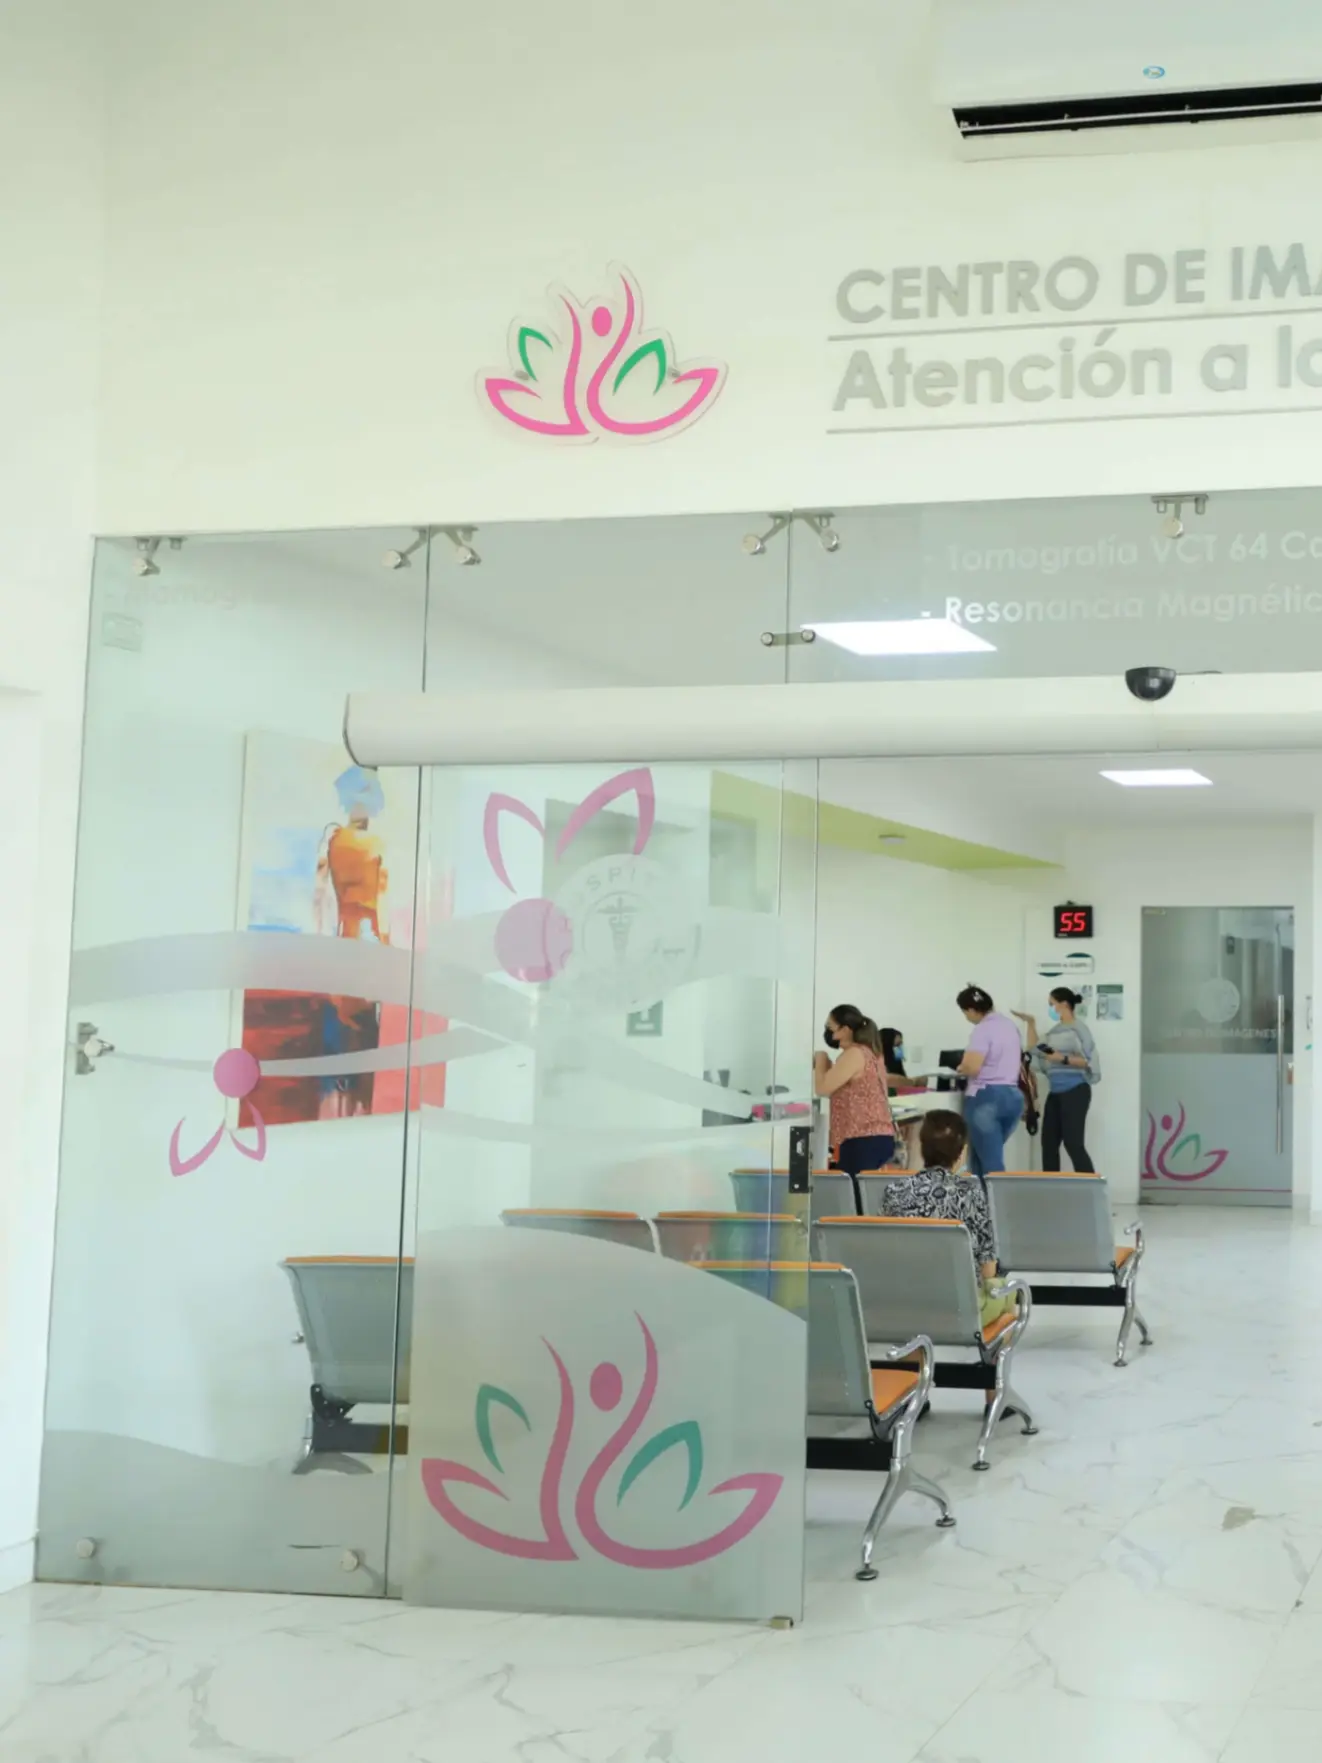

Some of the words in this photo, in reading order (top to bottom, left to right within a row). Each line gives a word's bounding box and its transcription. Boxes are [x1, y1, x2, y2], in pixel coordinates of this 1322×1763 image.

[835, 254, 1100, 324] CENTRO
[1122, 248, 1206, 307] DE
[832, 327, 1174, 411] Atención
[1200, 343, 1248, 392] a
[948, 536, 1138, 576] Tomografía
[1152, 533, 1217, 564] VCT
[1229, 535, 1269, 561] 64
[944, 594, 1143, 624] Resonancia
[1060, 912, 1086, 931] 55
